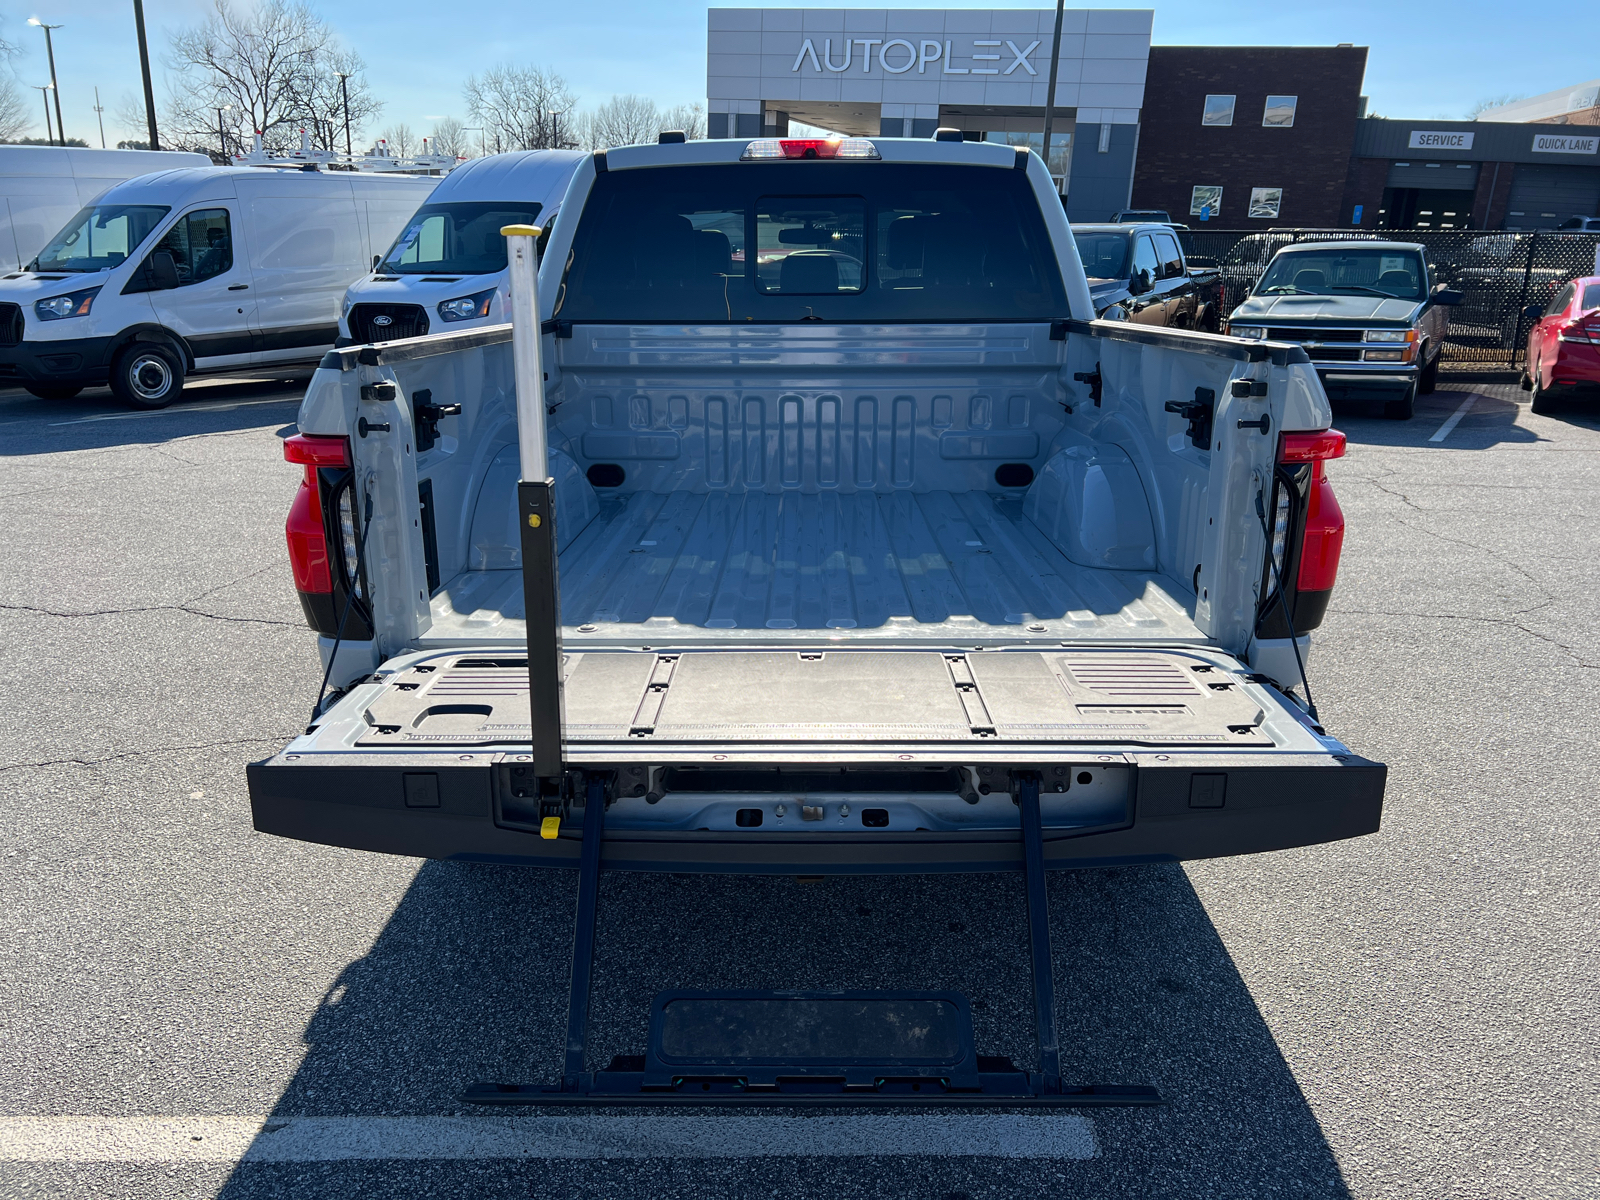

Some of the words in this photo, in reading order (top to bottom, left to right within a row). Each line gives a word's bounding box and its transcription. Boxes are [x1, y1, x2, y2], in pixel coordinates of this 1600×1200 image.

[791, 38, 1042, 76] AUTOPLEX
[1418, 134, 1465, 146] SERVICE
[1538, 137, 1567, 150] QUICK
[1568, 139, 1593, 151] LANE
[545, 818, 555, 829] 2
